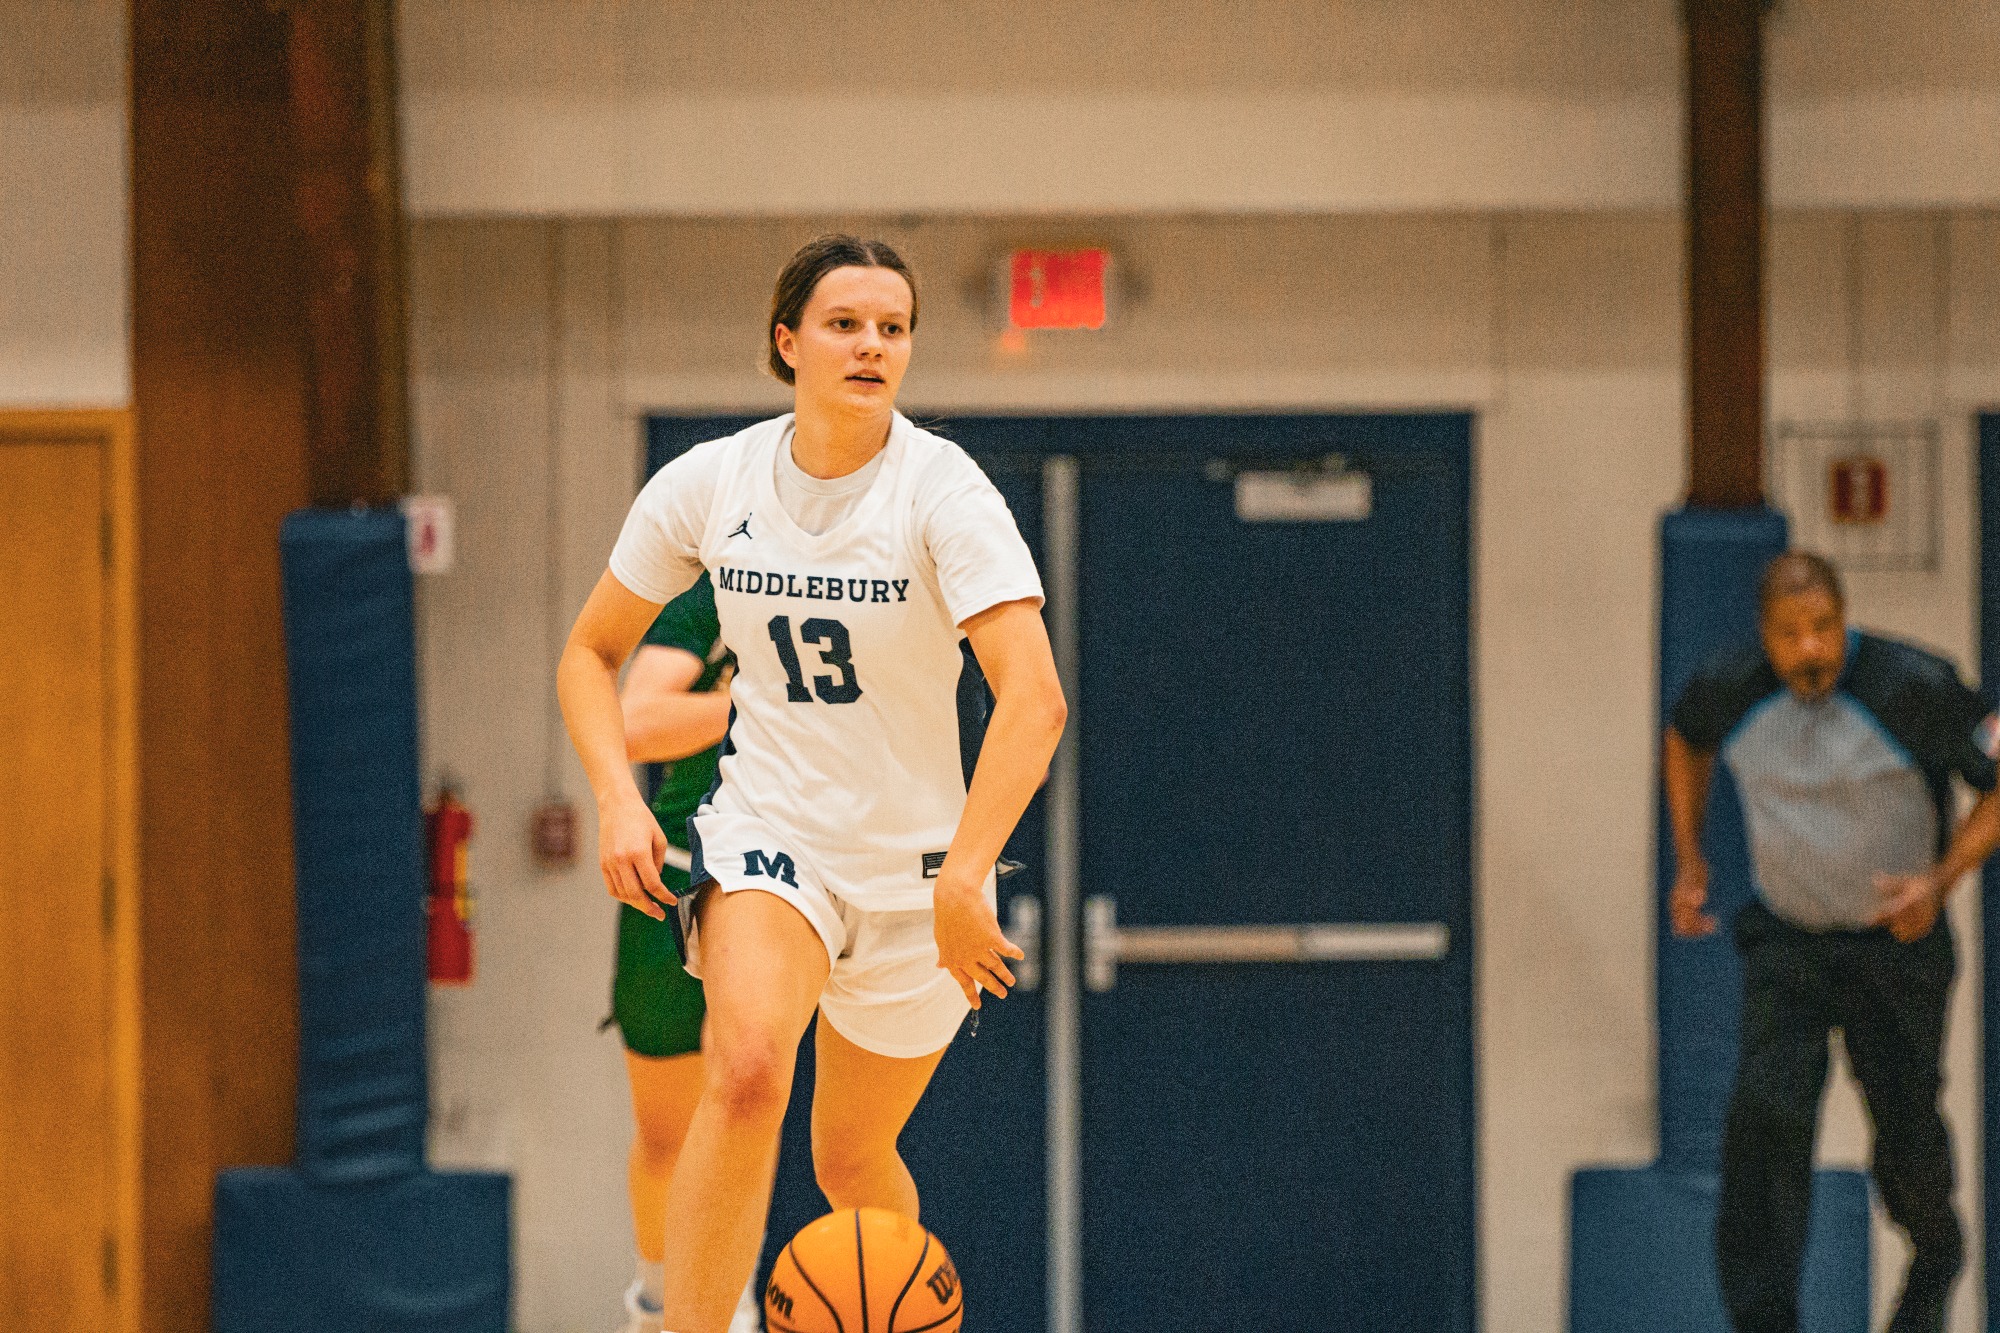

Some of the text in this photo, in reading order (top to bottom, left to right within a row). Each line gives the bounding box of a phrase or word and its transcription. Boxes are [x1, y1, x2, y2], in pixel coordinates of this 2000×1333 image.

[719, 566, 910, 603] MIDDLEBURY
[767, 615, 864, 705] 13
[742, 849, 800, 890] M
